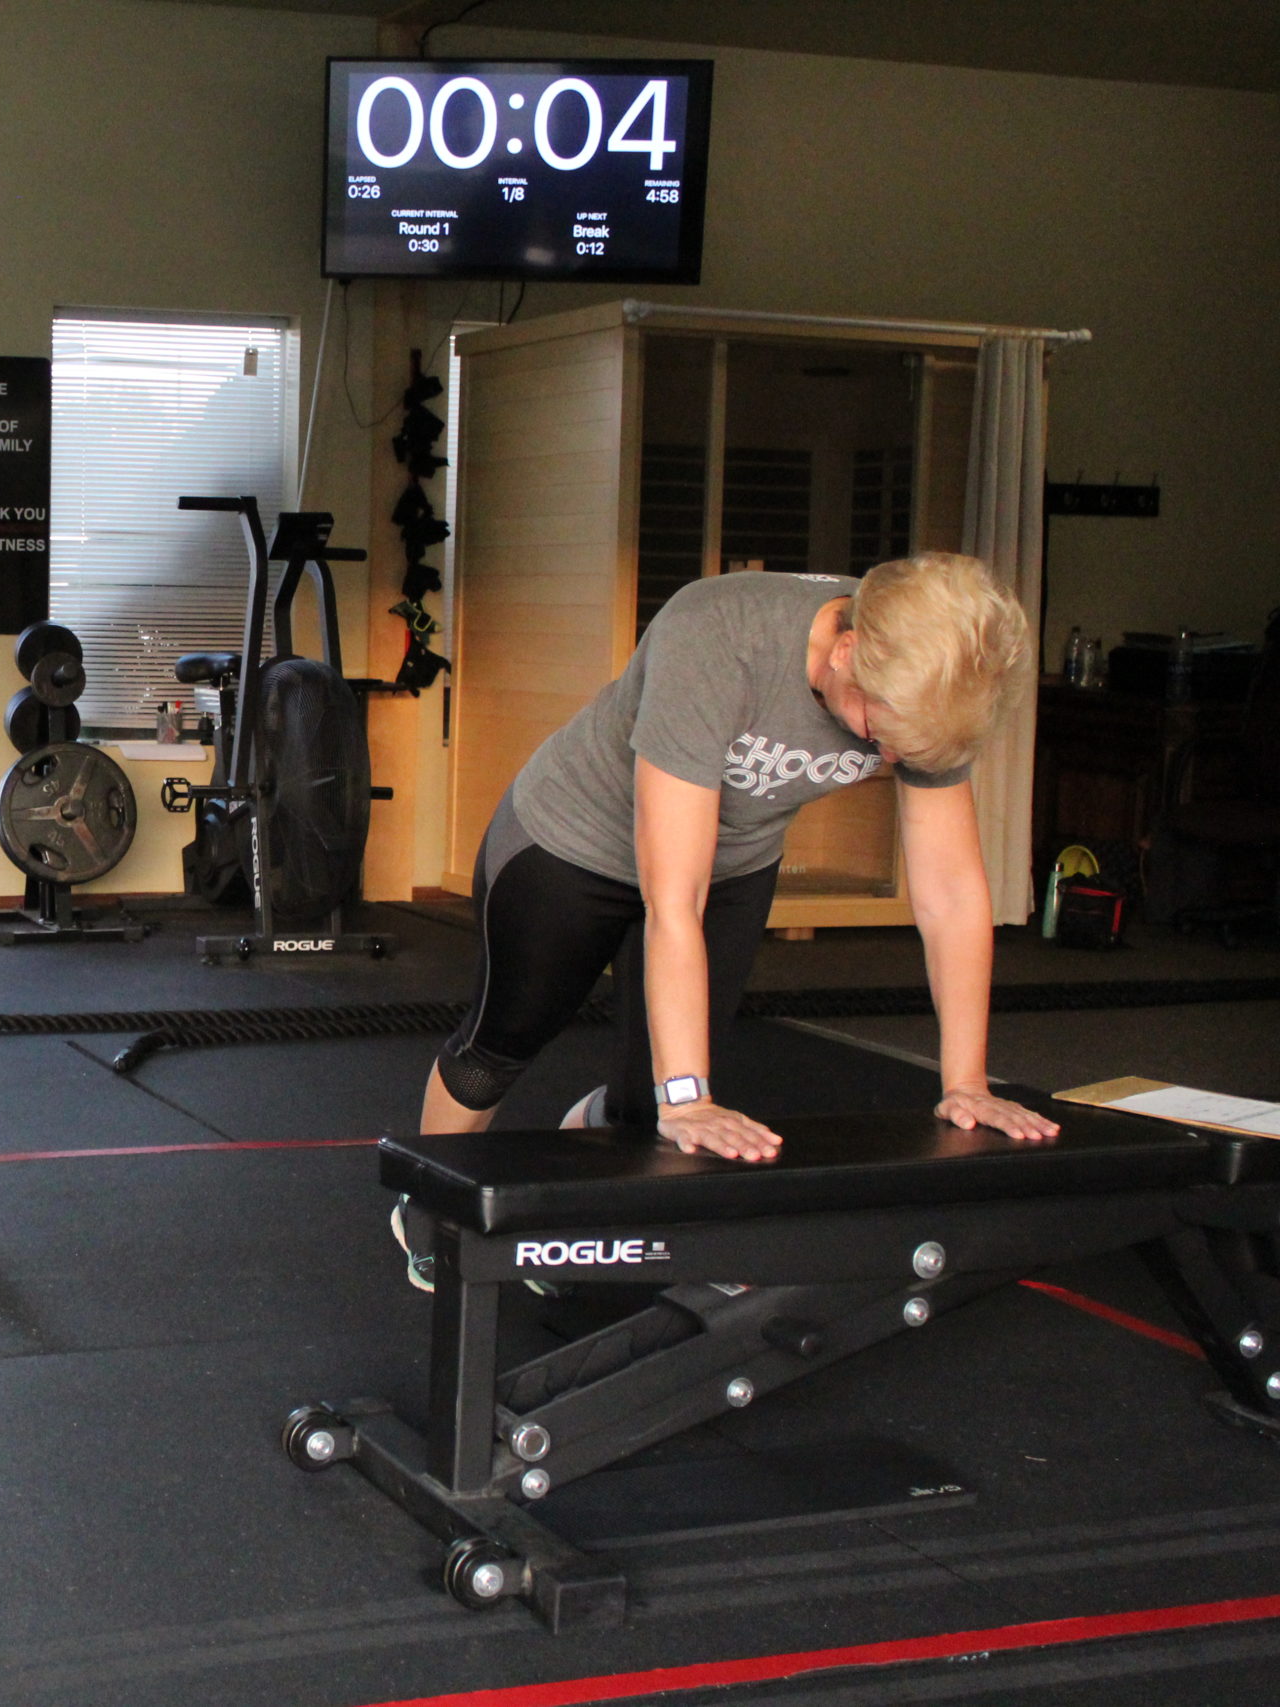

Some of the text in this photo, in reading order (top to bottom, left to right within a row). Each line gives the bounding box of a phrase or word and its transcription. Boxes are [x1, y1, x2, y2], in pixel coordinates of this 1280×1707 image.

[356, 75, 677, 171] 00:04
[348, 175, 377, 183] ELAPSED
[498, 177, 528, 185] INTERVAL
[645, 179, 680, 188] REMAINING
[348, 184, 381, 199] 0:26
[502, 187, 525, 203] 1/8
[646, 189, 679, 204] 4:58
[391, 209, 459, 219] CURRENT INTERVAL
[576, 212, 607, 221] UP NEXT
[399, 221, 450, 236] Round 1
[573, 224, 610, 238] Break
[408, 238, 440, 253] 0:30
[576, 241, 605, 256] 0:12
[14, 508, 46, 521] YOU
[251, 816, 262, 912] ROGUE
[273, 940, 335, 952] ROGUE
[515, 1240, 646, 1266] ROGUE
